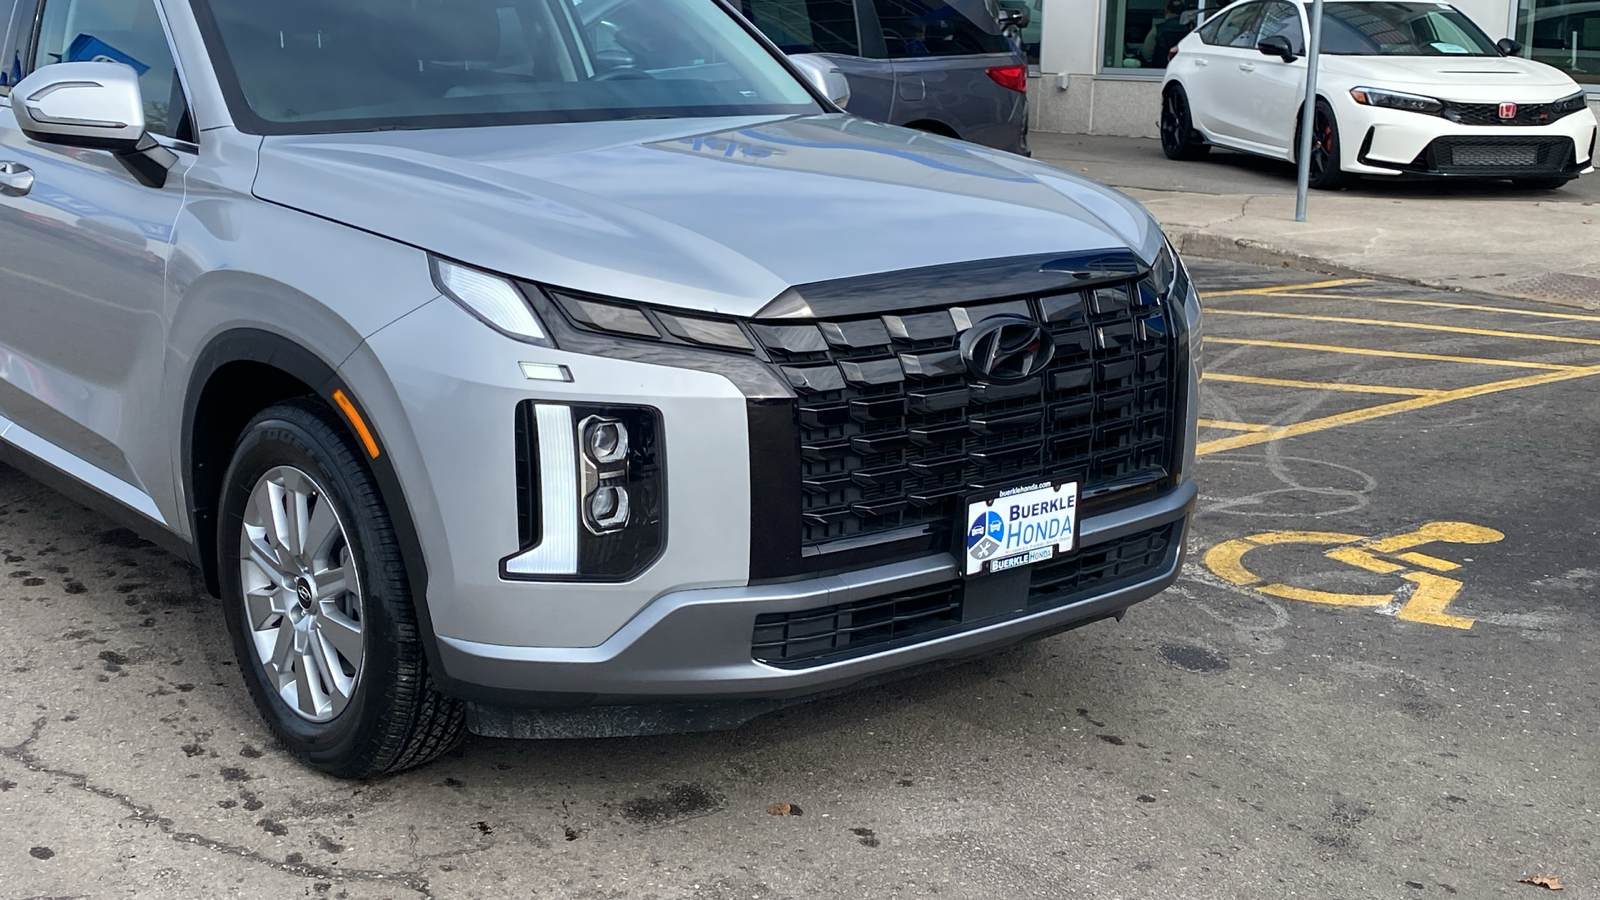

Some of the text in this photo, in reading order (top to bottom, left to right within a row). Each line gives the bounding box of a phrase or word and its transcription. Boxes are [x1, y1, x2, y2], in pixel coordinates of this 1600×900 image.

[999, 481, 1051, 497] buerklehonda.com
[1009, 495, 1075, 522] BUERKLE
[1006, 515, 1072, 549] HONDA
[992, 550, 1051, 571] BUERKLE HONDA
